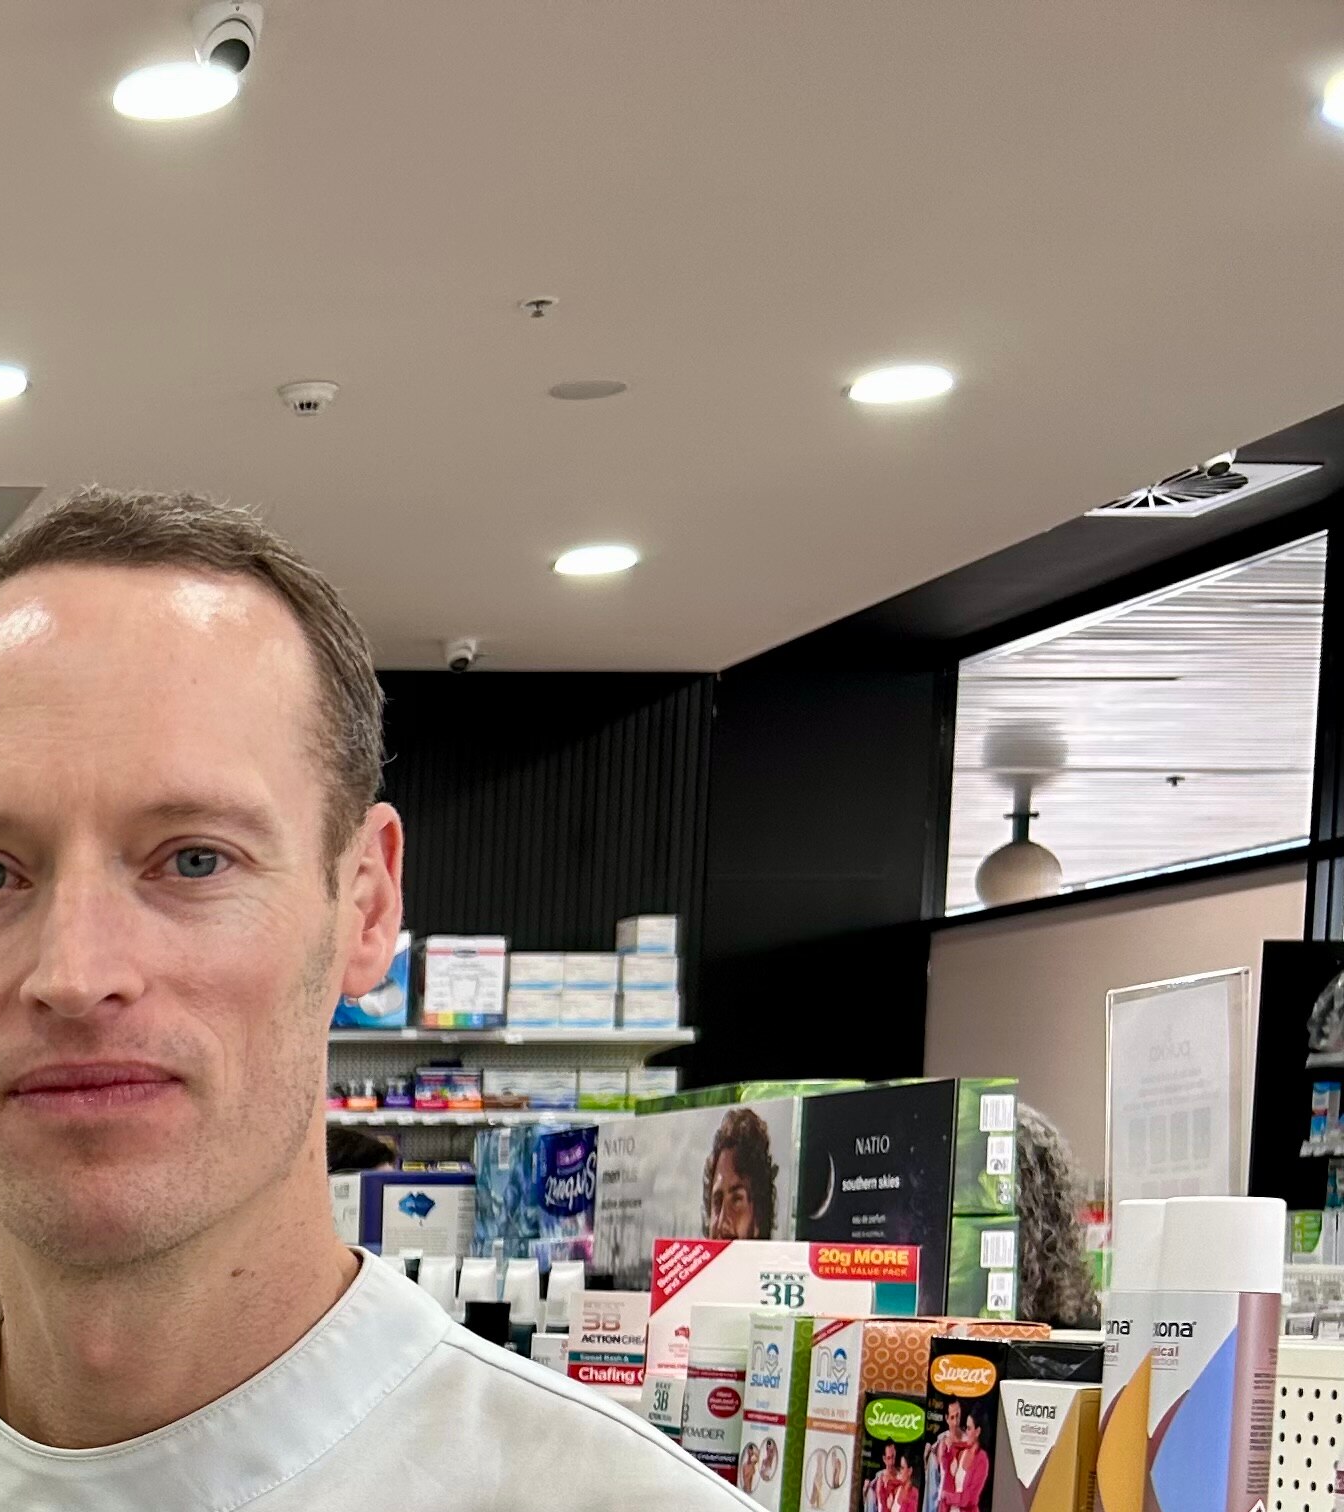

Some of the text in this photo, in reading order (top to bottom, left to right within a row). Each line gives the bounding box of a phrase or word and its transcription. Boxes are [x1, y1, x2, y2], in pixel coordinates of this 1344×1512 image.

[855, 1135, 890, 1155] NATIO
[878, 1175, 900, 1190] skies
[818, 1248, 910, 1270] 20g MORE
[819, 1266, 845, 1275] EXTRA
[849, 1267, 878, 1276] VALUE
[760, 1283, 805, 1309] 3B
[582, 1310, 621, 1330] 3B
[582, 1334, 621, 1344] ACTION
[578, 1367, 633, 1386] Chafing
[750, 1371, 780, 1388] sweat
[936, 1357, 992, 1385] Sweax
[815, 1376, 848, 1396] sweat
[654, 1389, 669, 1411] 3B
[1015, 1398, 1057, 1420] Rexona
[868, 1403, 921, 1431] Sweax
